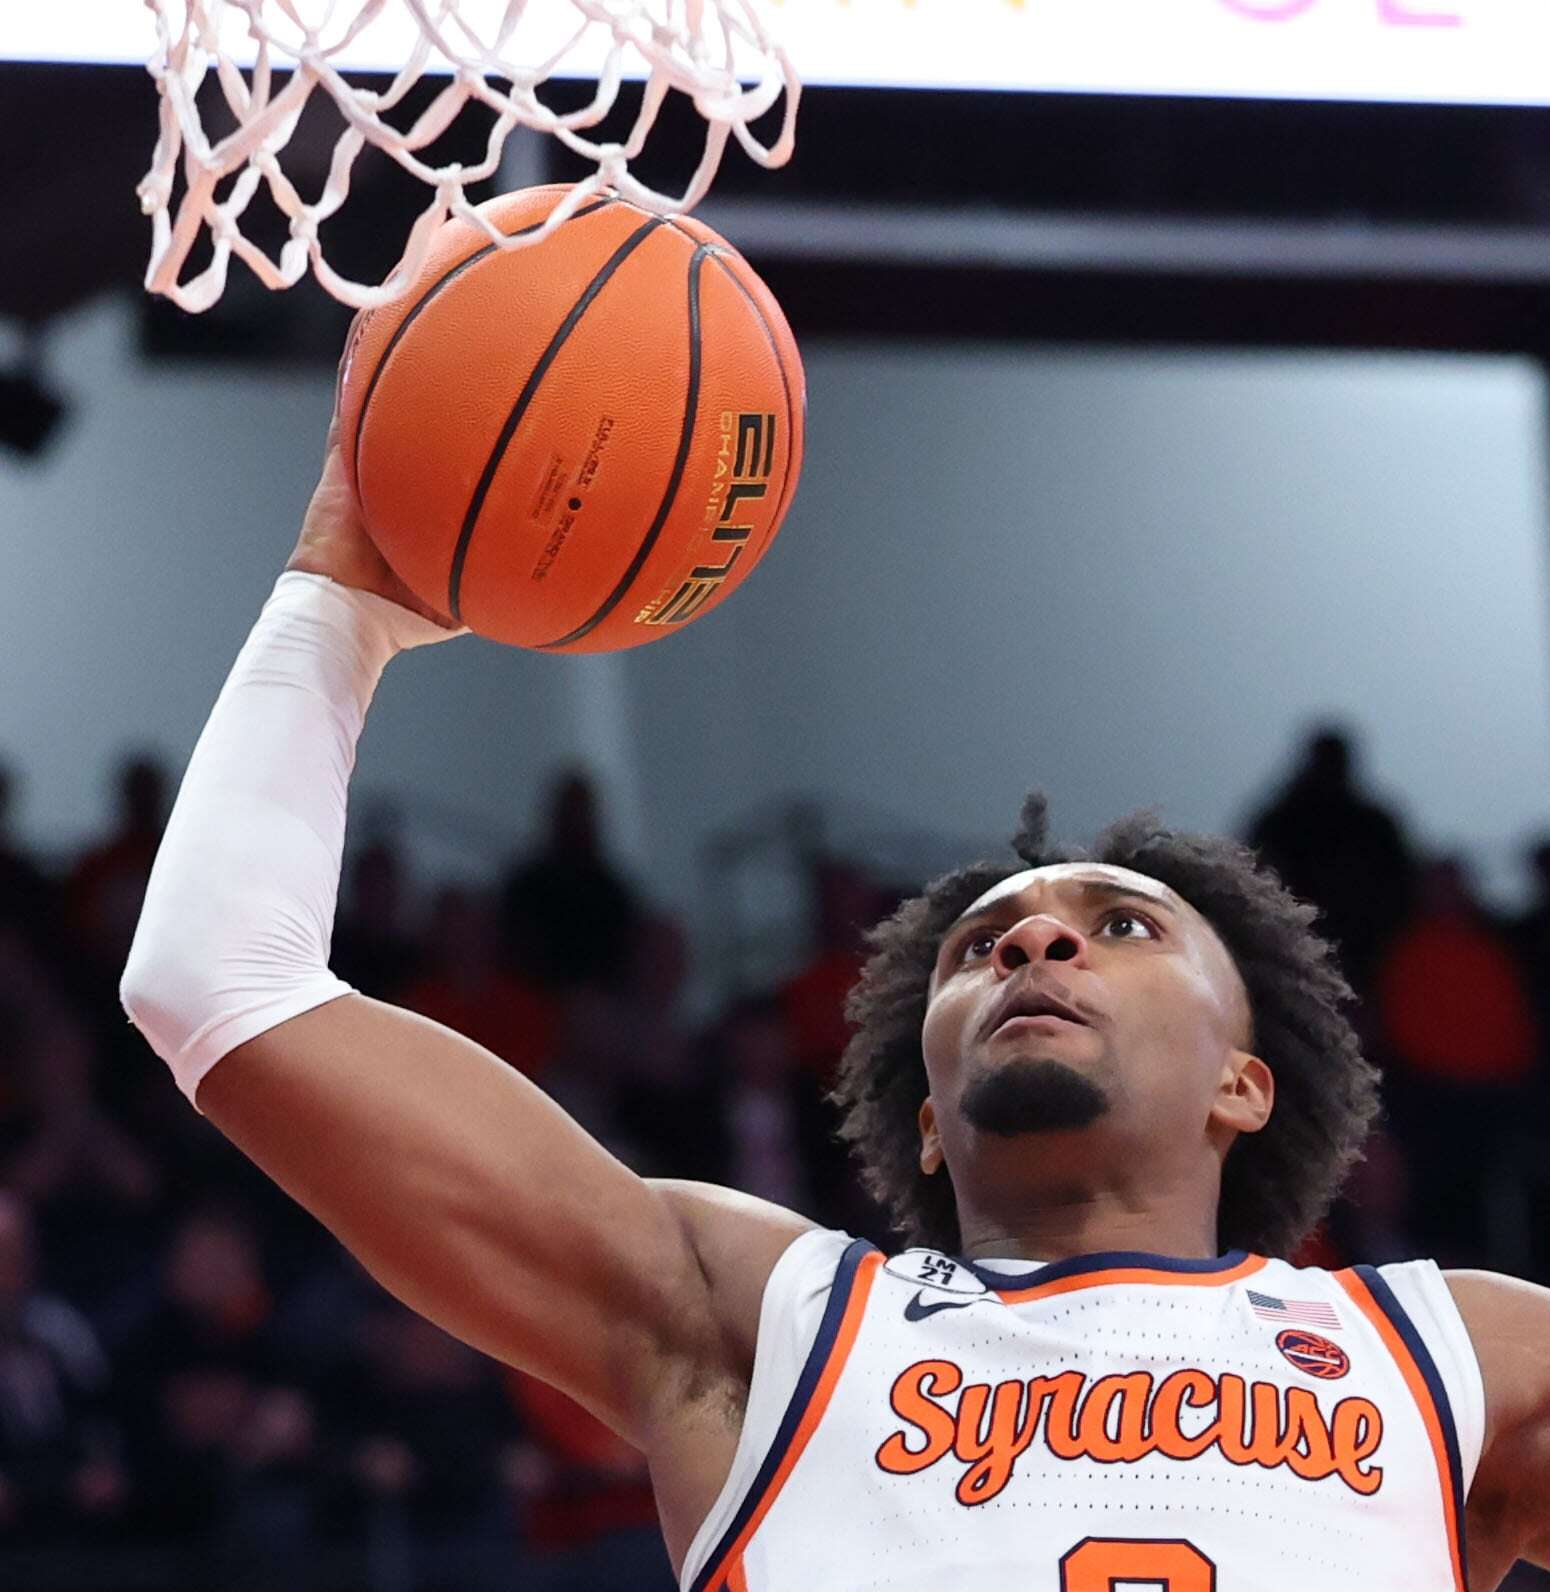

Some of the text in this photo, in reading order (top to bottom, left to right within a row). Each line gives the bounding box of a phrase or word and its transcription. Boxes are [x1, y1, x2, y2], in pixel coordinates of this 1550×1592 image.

[646, 412, 777, 624] ELITE
[917, 1265, 953, 1285] 21
[924, 1255, 957, 1273] LM
[876, 1359, 1384, 1507] Syracuse
